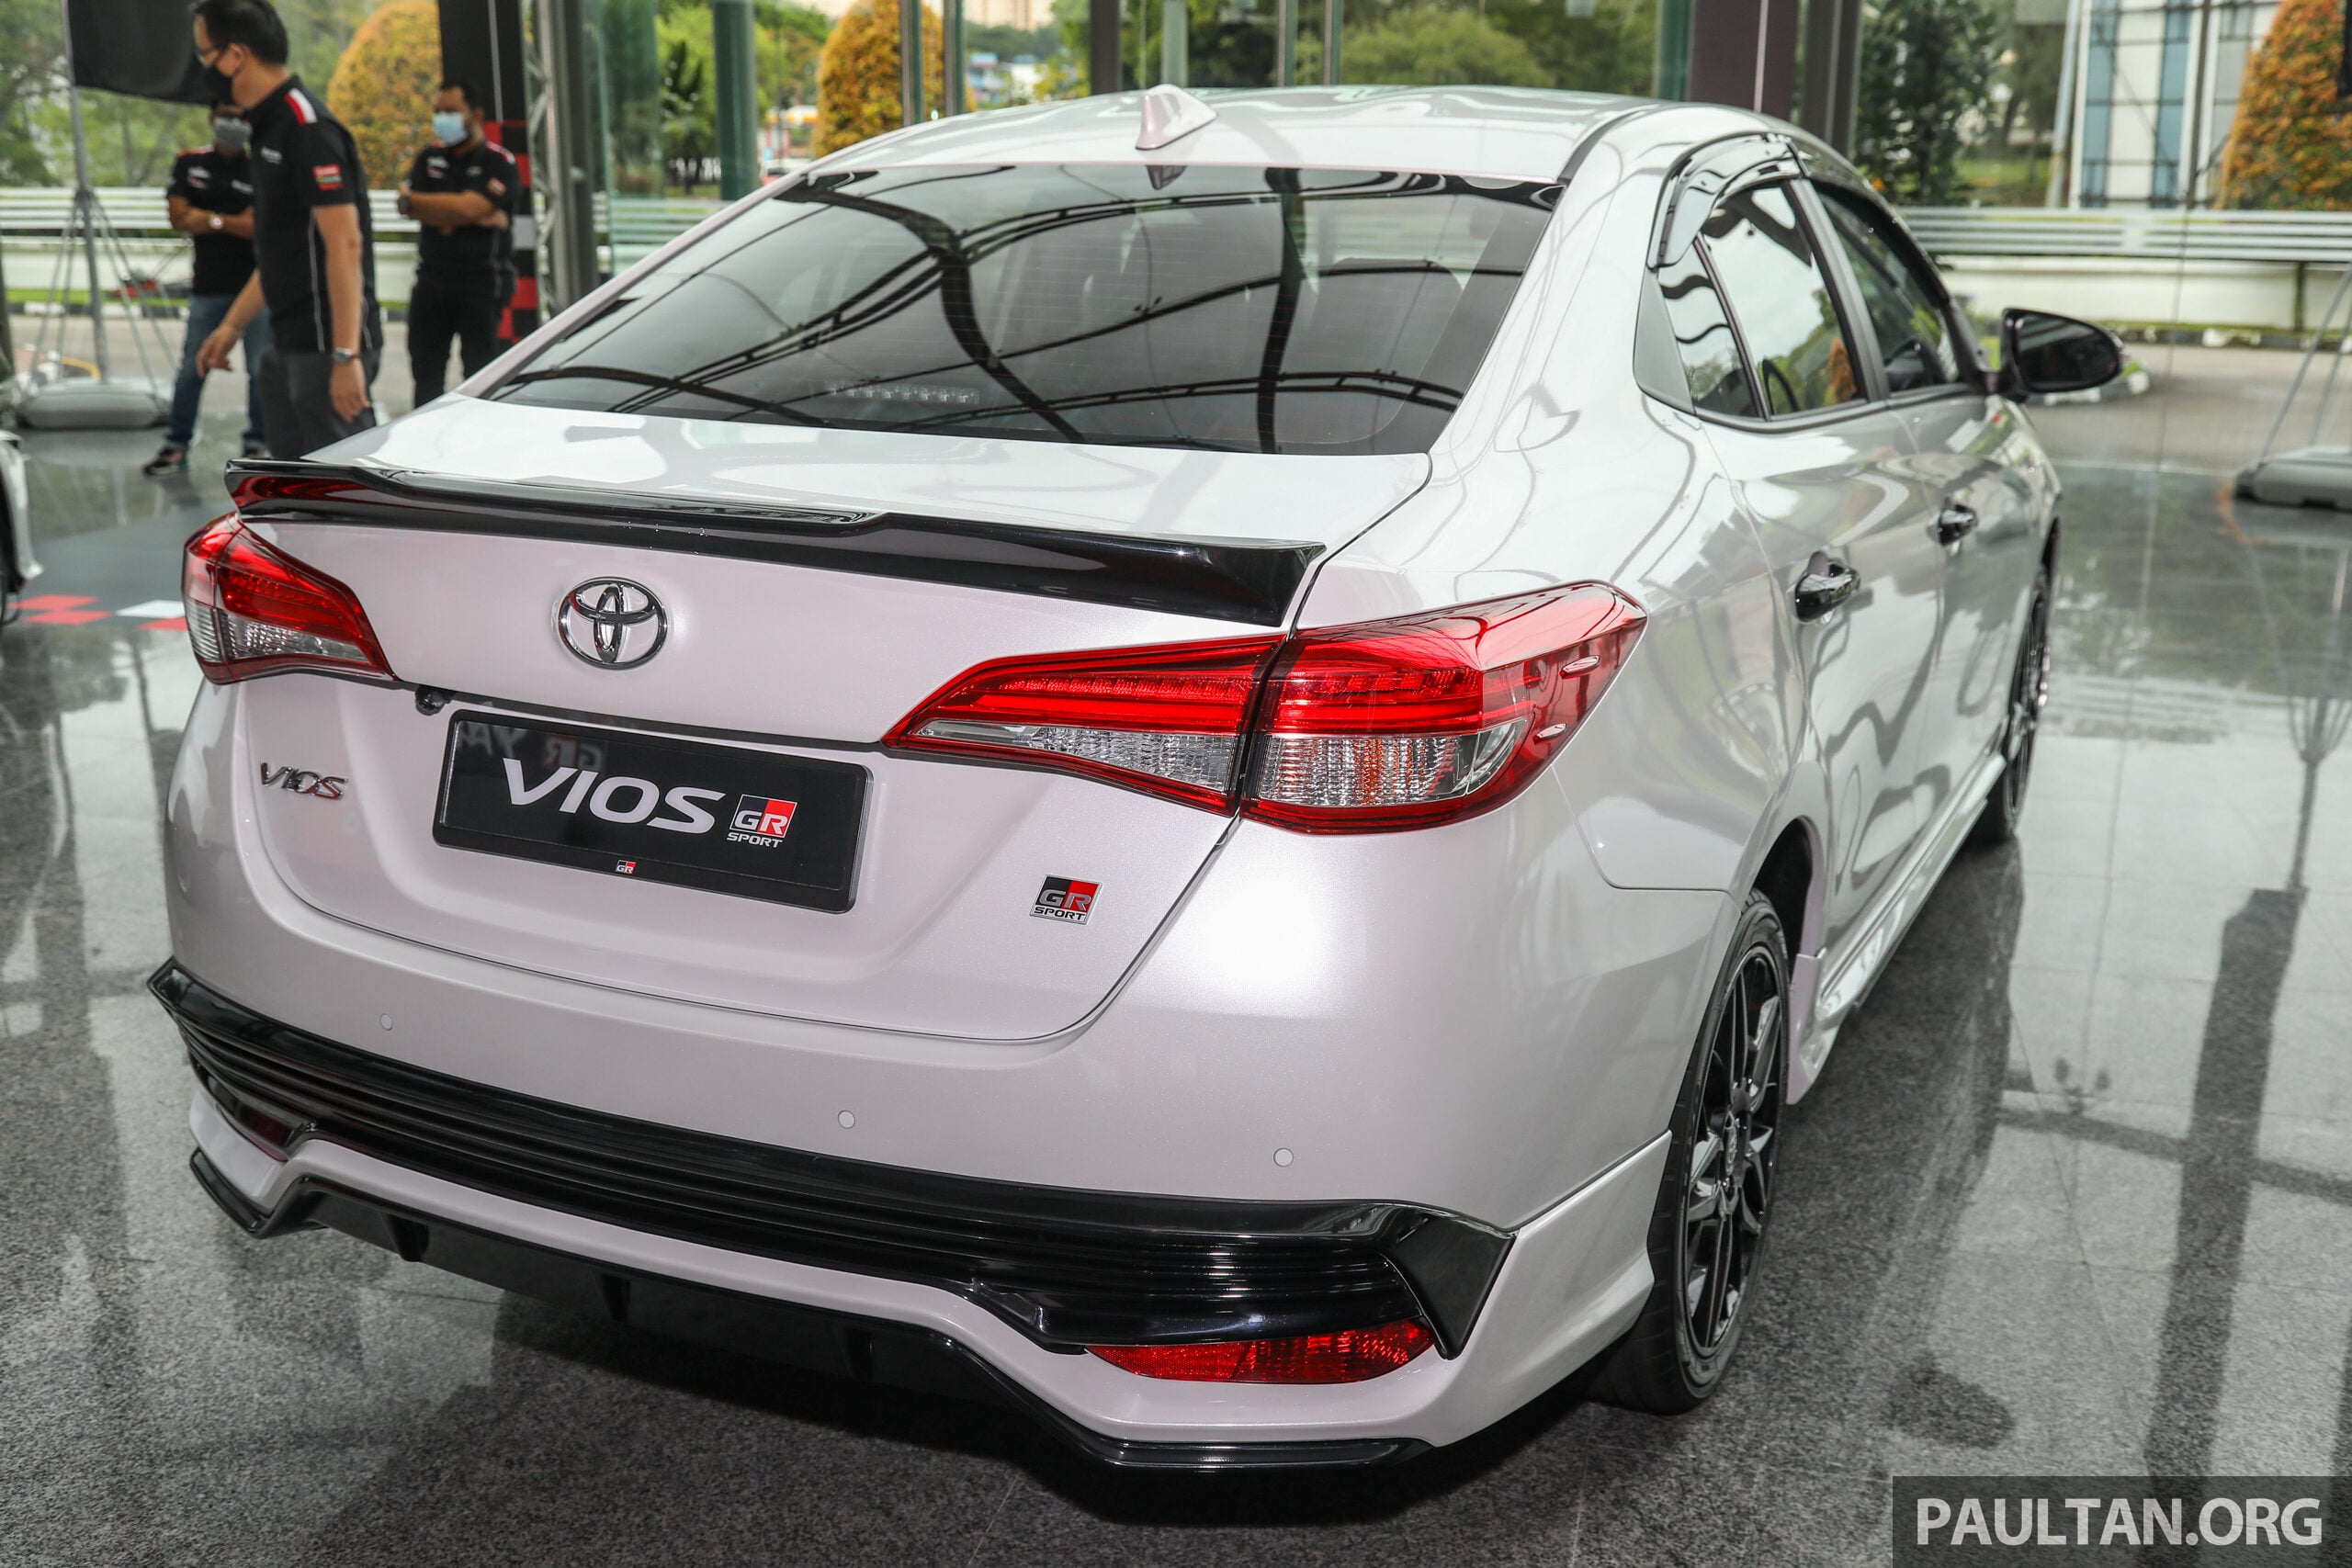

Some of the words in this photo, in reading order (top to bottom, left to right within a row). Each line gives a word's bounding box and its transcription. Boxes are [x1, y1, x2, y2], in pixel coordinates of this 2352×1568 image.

[260, 761, 348, 800] VIOS
[503, 758, 726, 834] VIOS
[734, 809, 789, 835] GR
[726, 832, 783, 848] SPORT
[1039, 889, 1091, 911] GR
[1034, 907, 1086, 920] SPORT
